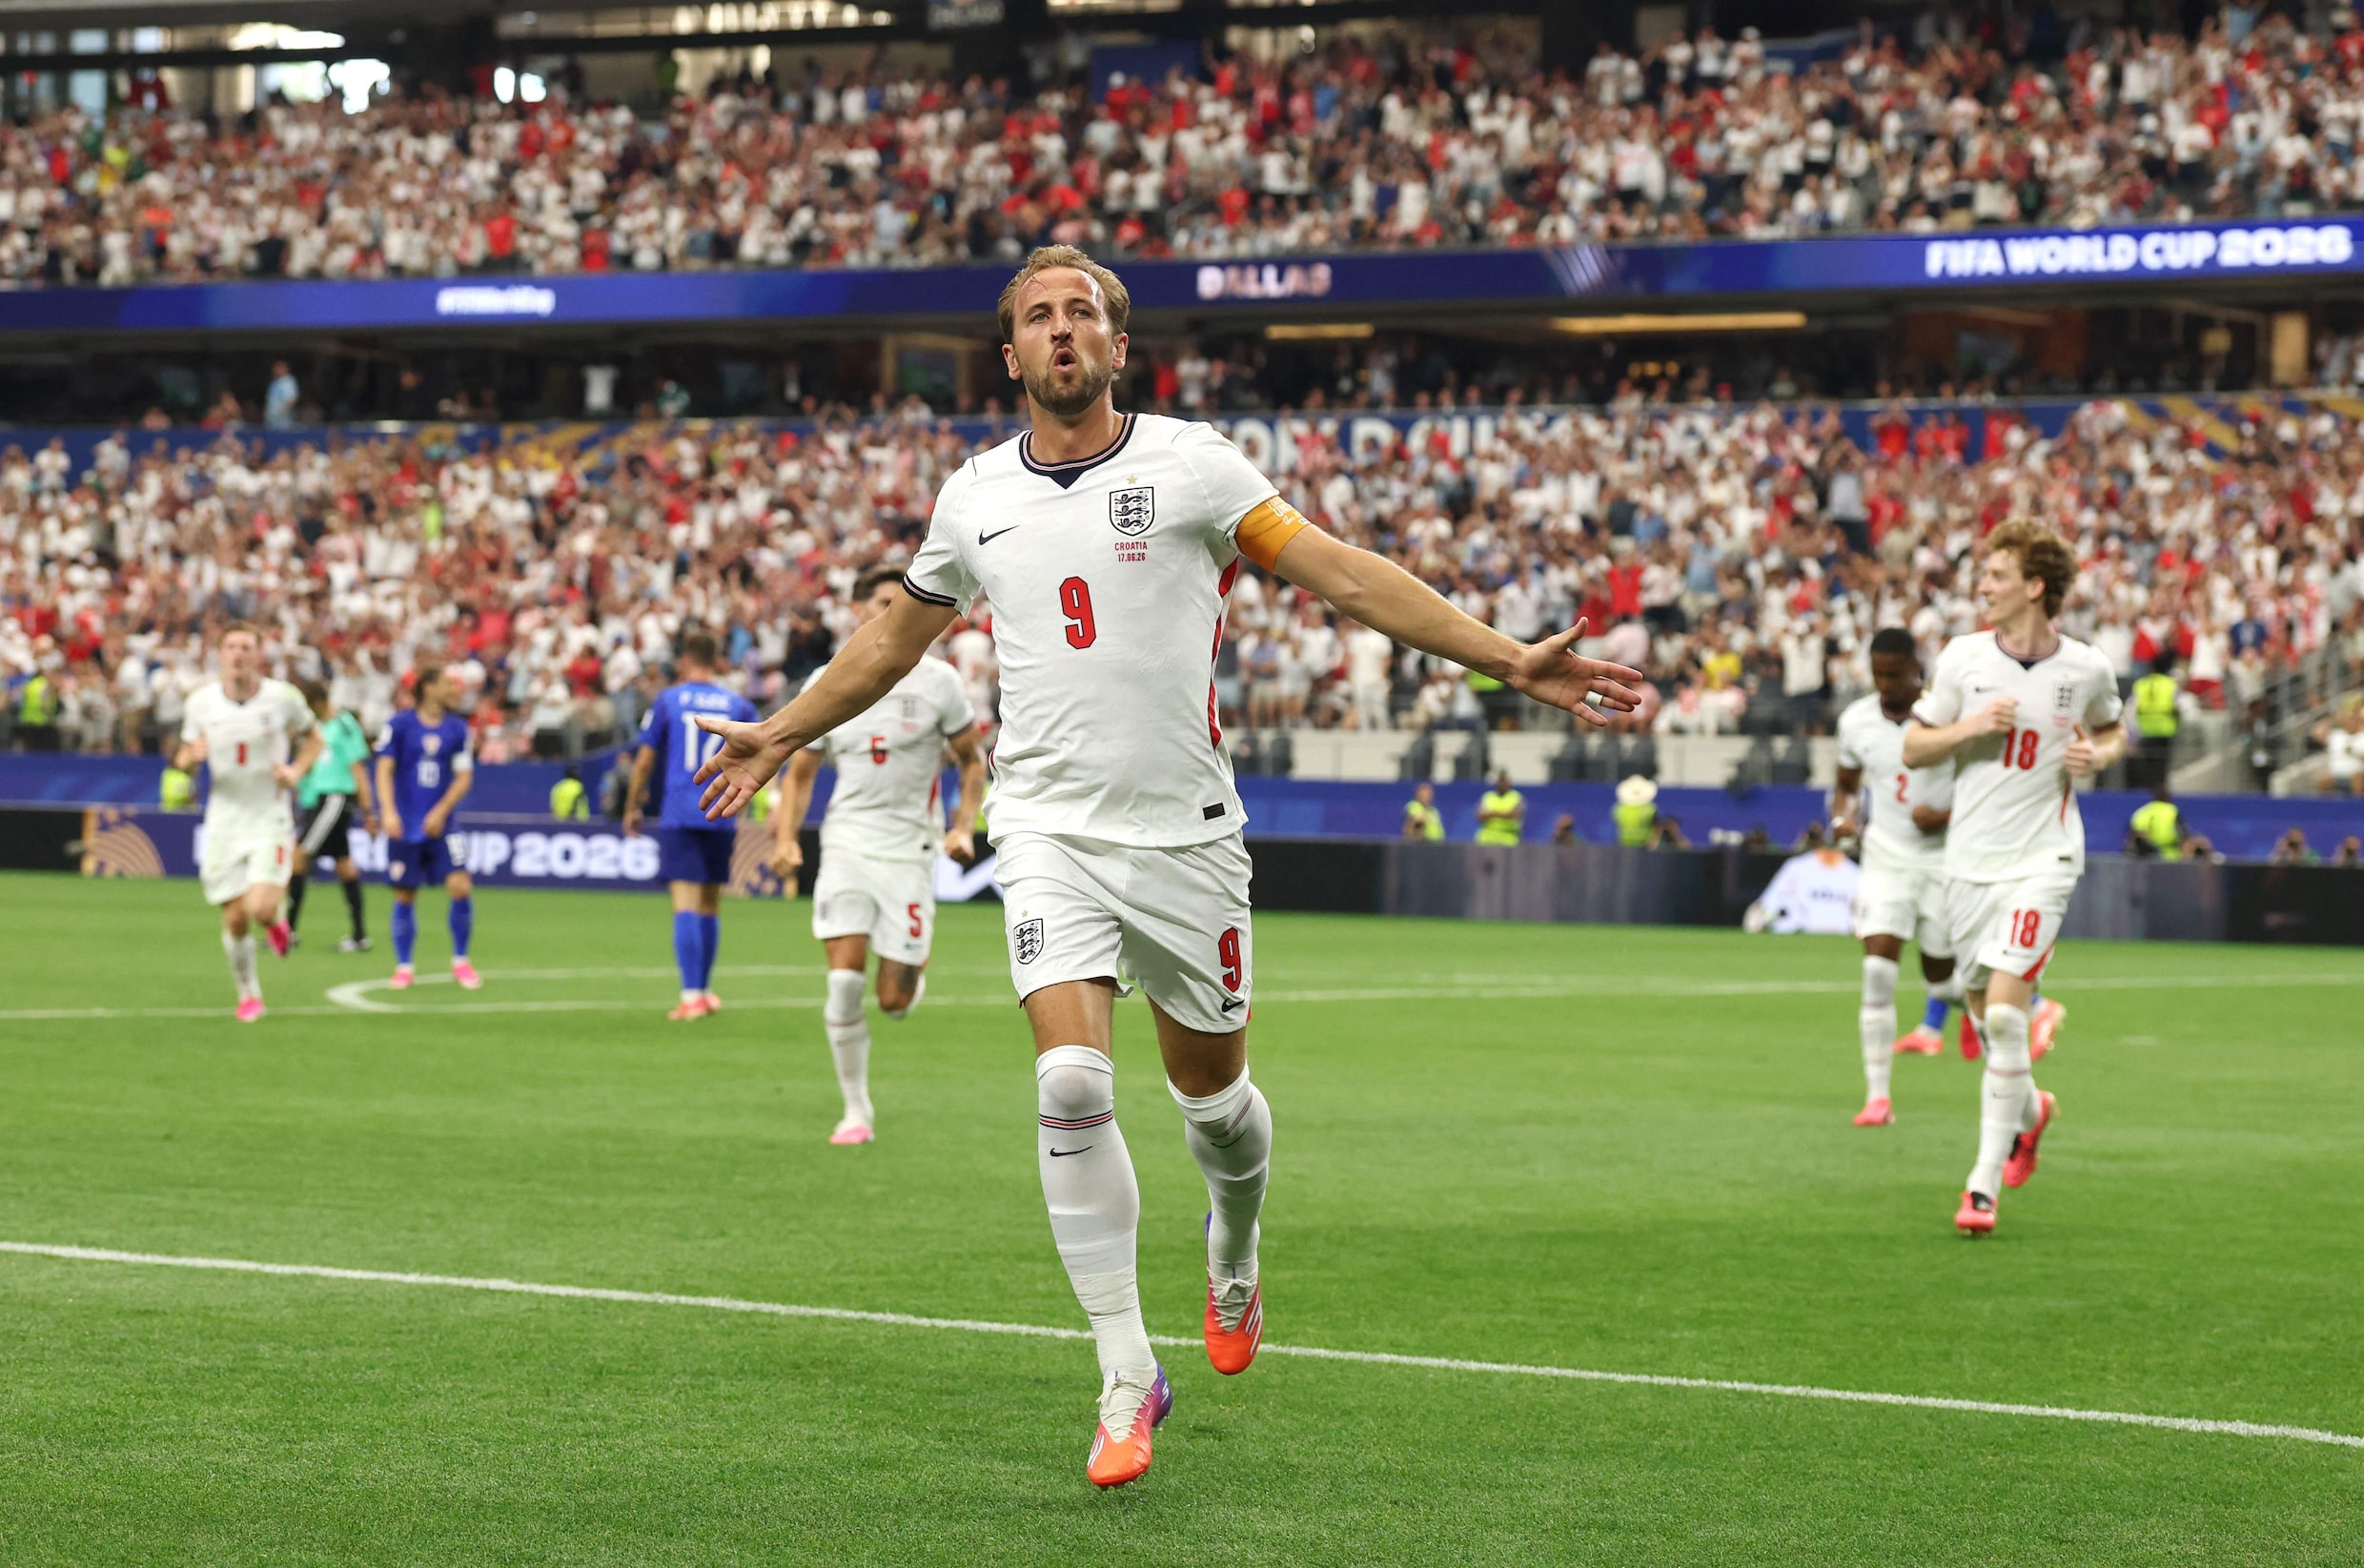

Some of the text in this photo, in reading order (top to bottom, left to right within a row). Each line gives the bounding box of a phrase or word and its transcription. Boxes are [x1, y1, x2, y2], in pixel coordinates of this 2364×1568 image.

[1925, 225, 2354, 277] FIFA WORLD CUP 2026
[1196, 262, 1332, 299] DALLAS
[1114, 540, 1148, 551] CROATIA
[1117, 552, 1146, 562] 17.06.26
[1059, 576, 1096, 650] 9
[2004, 726, 2040, 770] 18
[1895, 772, 1908, 803] 2
[512, 831, 661, 881] 2026
[908, 903, 923, 938] 5
[2010, 908, 2041, 948] 18
[1218, 927, 1242, 993] 9
